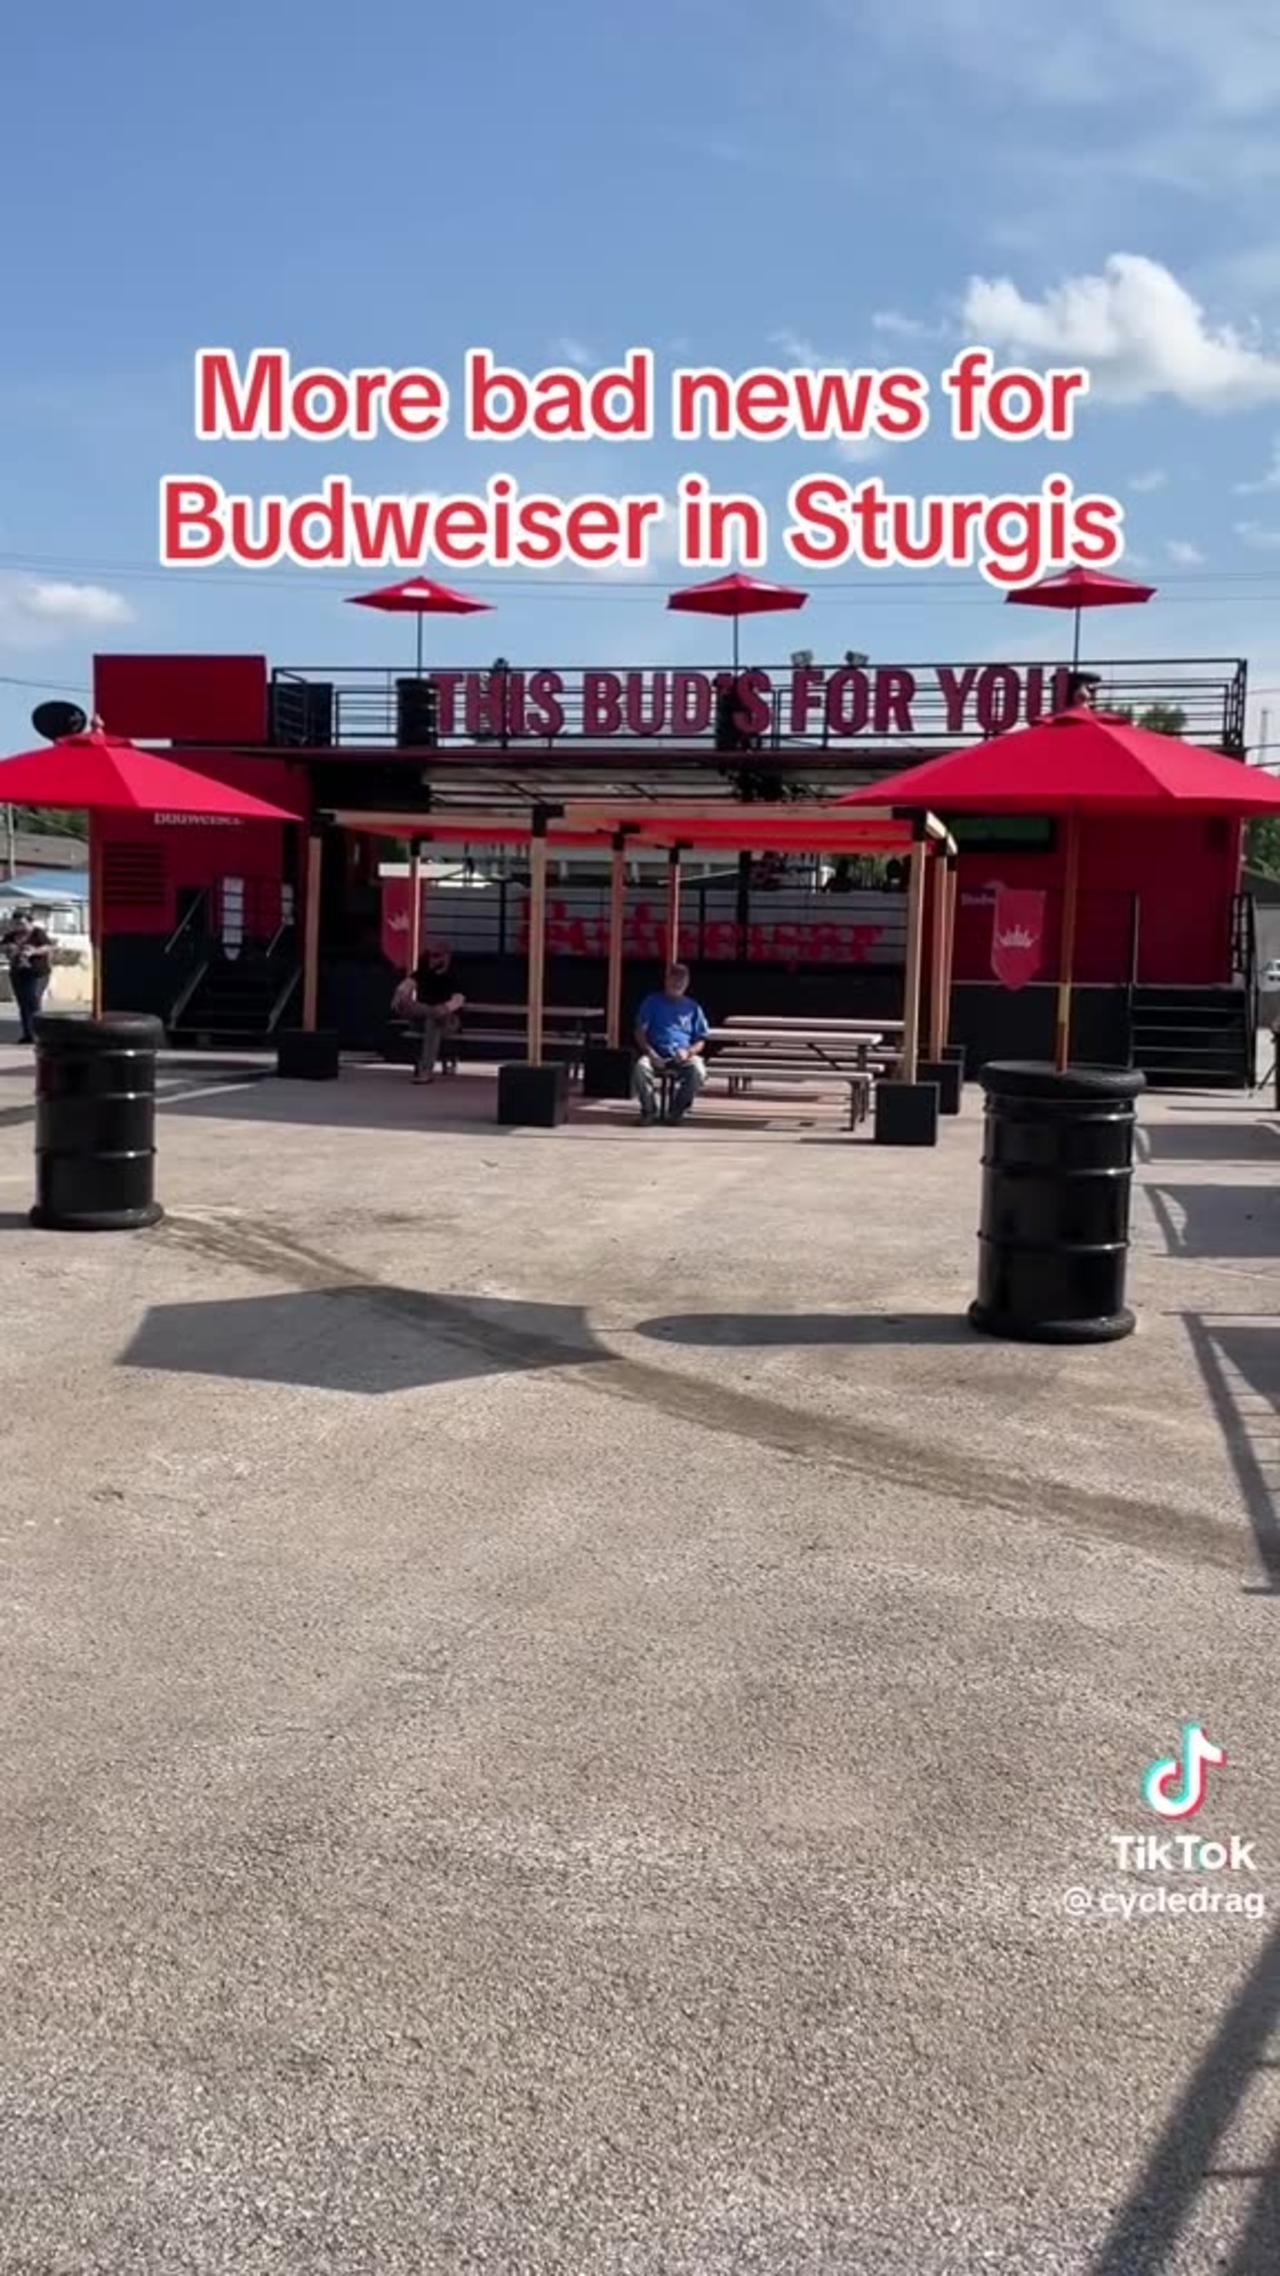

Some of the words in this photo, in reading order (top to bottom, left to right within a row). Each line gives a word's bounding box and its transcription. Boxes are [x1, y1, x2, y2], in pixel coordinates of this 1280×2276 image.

[430, 671, 564, 736] THIS
[582, 668, 773, 736] BUD'S
[789, 665, 916, 735] FOR
[935, 663, 1073, 734] YOU
